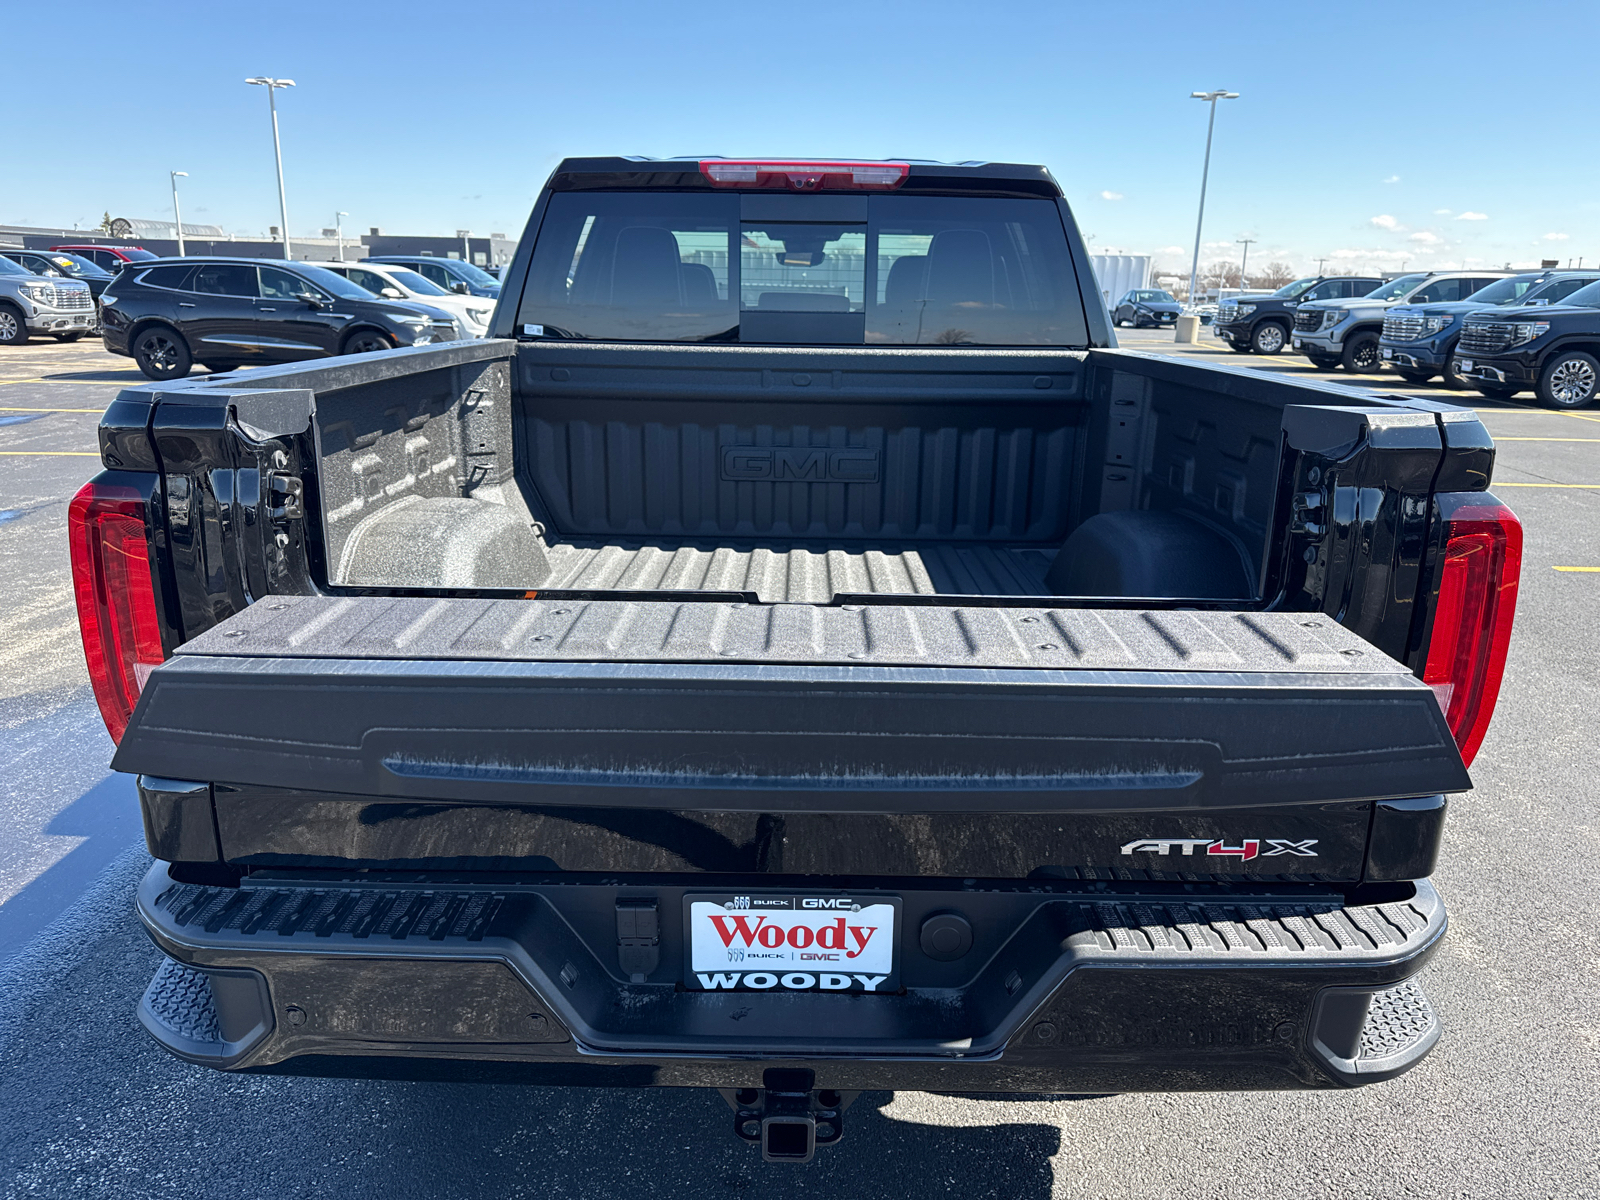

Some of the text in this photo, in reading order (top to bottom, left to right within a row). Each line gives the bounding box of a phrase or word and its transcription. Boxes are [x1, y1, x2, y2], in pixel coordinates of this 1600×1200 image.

[724, 450, 877, 480] GMC
[1120, 839, 1318, 862] AT4X
[802, 898, 853, 909] GMC
[707, 915, 878, 959] Woody
[800, 952, 840, 962] GMC
[696, 972, 888, 992] WOODY
